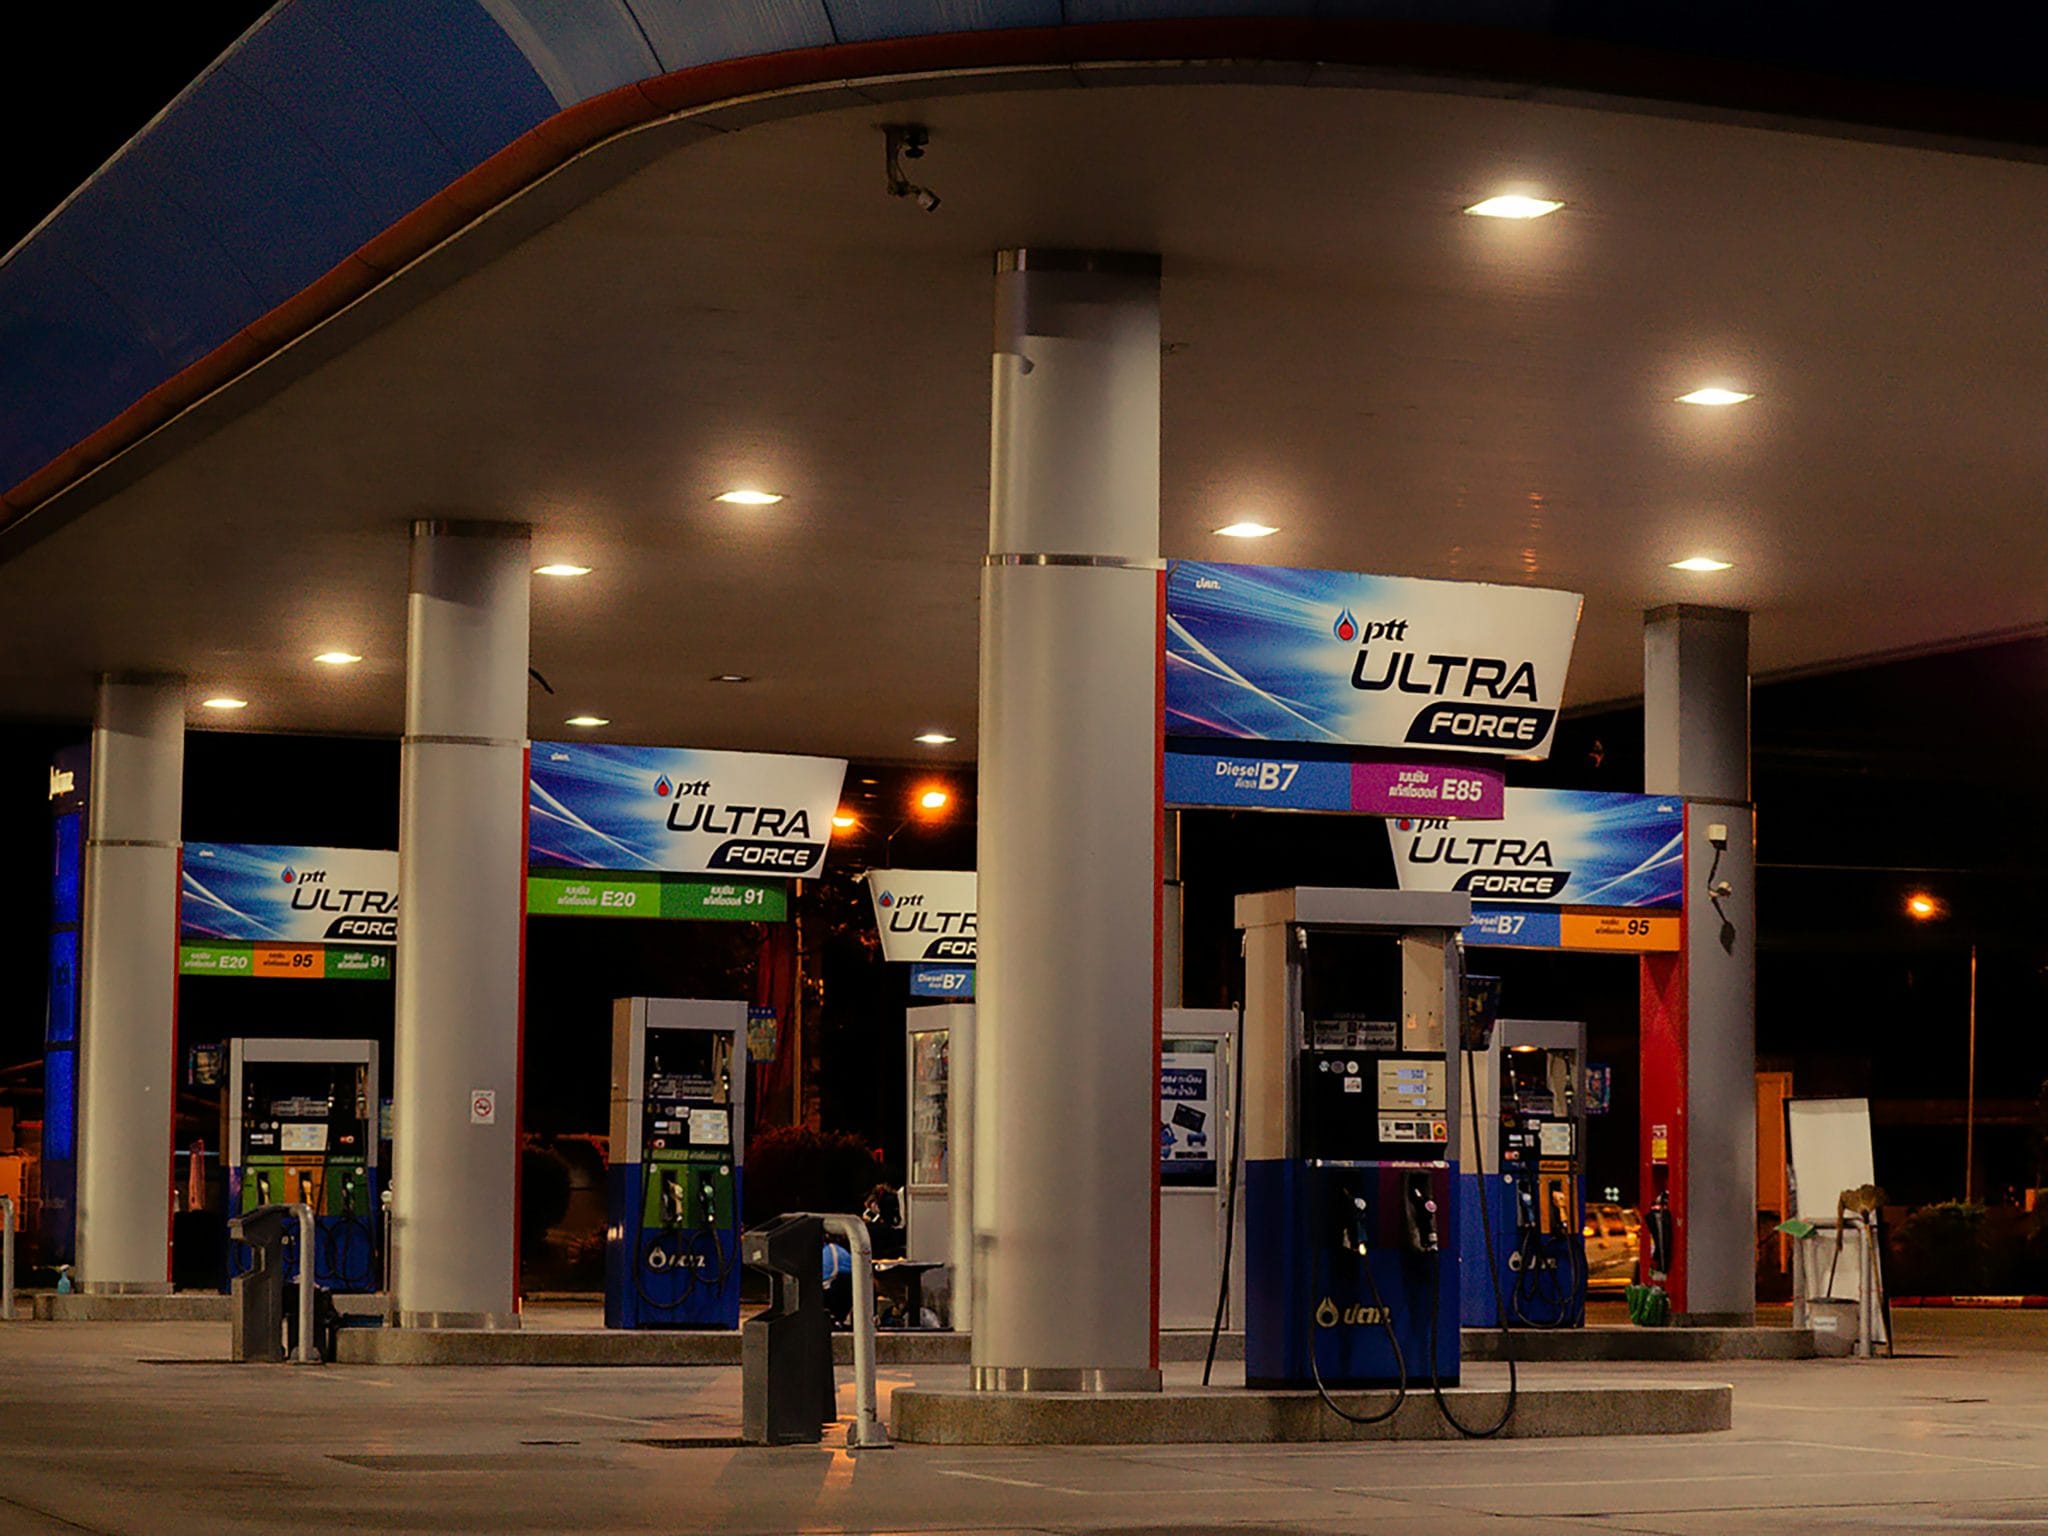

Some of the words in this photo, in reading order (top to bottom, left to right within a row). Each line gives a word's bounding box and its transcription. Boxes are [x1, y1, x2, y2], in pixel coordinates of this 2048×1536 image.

[1362, 618, 1409, 644] ptt
[1351, 649, 1539, 702] ULTRA
[1429, 711, 1538, 741] FORCE
[1215, 761, 1261, 777] Diesel
[1259, 762, 1300, 791] B7
[675, 780, 712, 799] ptt
[1441, 777, 1483, 802] E85
[666, 802, 811, 839] ULTRA
[725, 846, 811, 866] FORCE
[1408, 836, 1553, 867] ULTRA
[298, 868, 327, 885] ptt
[1467, 875, 1554, 894] FORCE
[601, 890, 637, 908] E20
[744, 889, 765, 905] 91
[896, 894, 925, 909] ptt
[339, 921, 398, 936] FORC
[889, 911, 976, 934] ULTR
[1497, 915, 1526, 935] B7
[1627, 919, 1650, 936] 95
[937, 941, 976, 955] FOR
[219, 955, 248, 969] E20
[292, 953, 314, 968] 95
[370, 954, 386, 969] 91
[943, 974, 967, 990] B7
